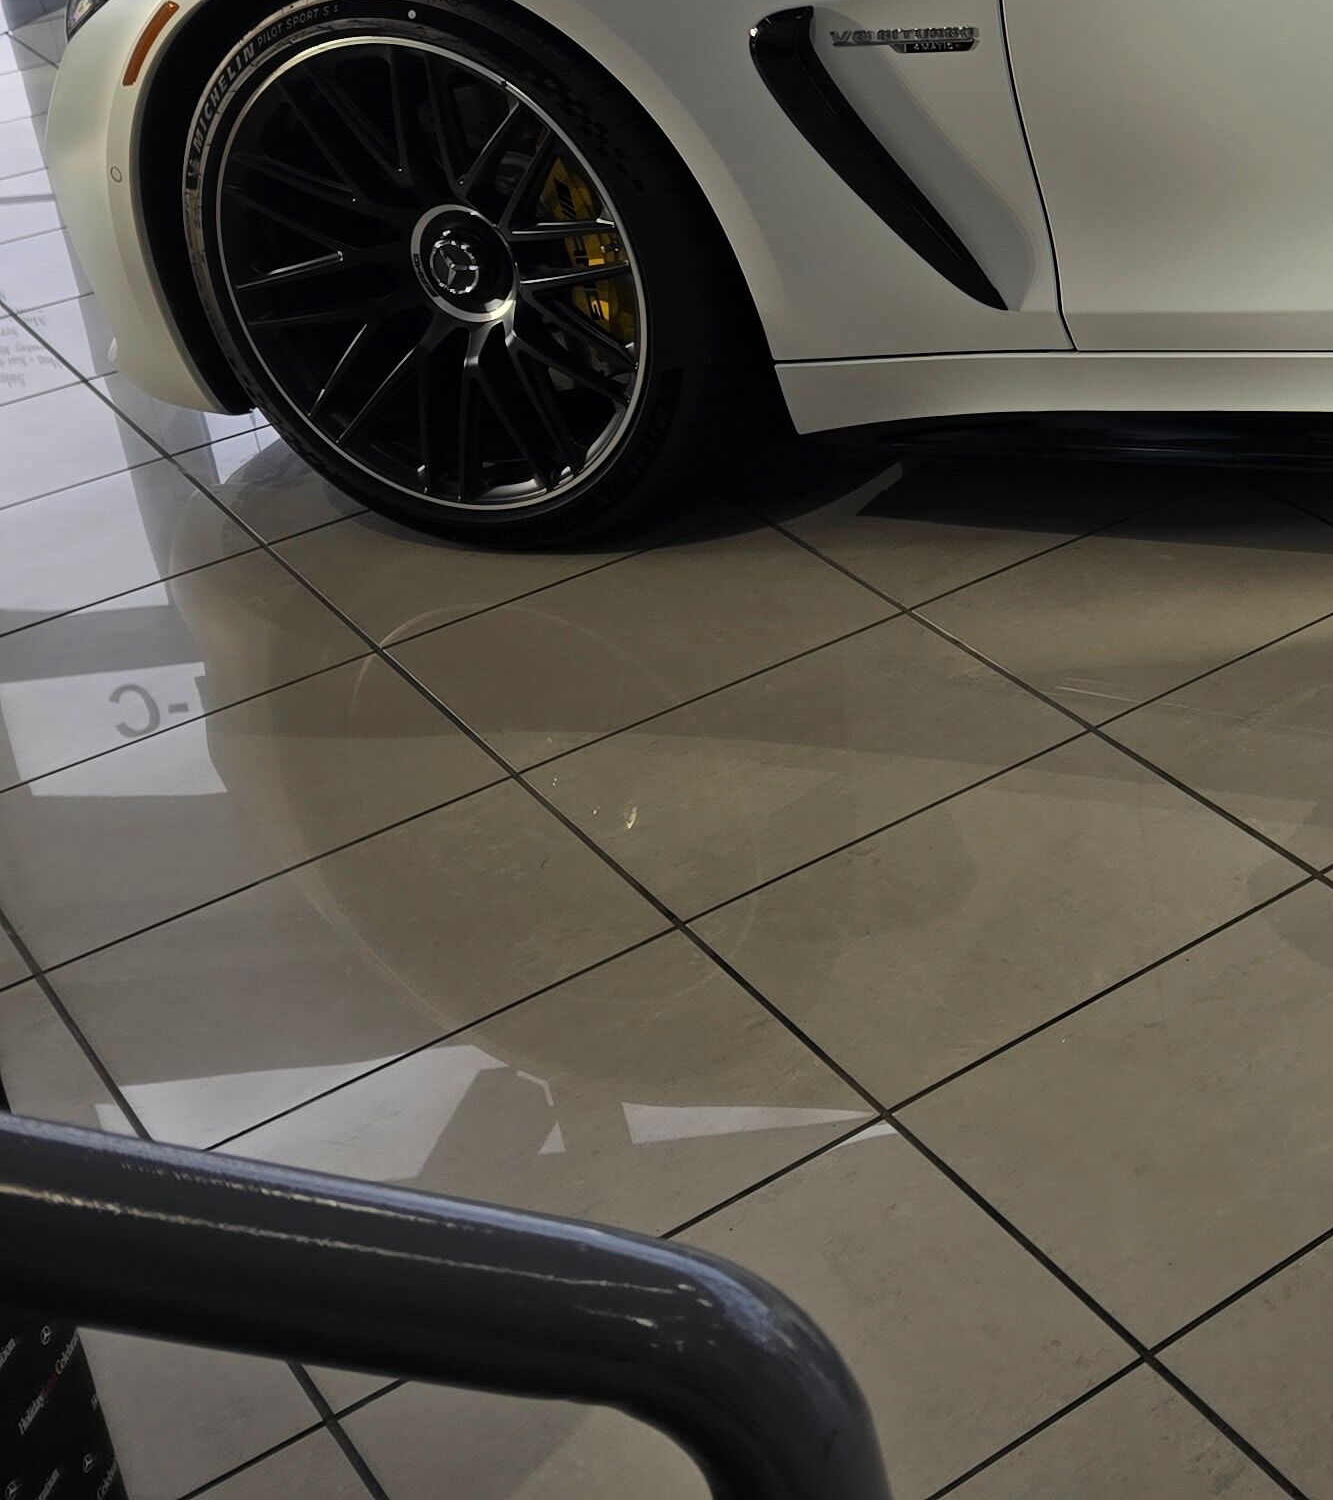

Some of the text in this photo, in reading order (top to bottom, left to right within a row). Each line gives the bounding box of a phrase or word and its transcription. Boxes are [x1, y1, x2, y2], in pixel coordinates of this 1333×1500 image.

[193, 42, 256, 154] MICHELIN
[257, 24, 285, 48] PILOT
[286, 8, 320, 30] SPORT
